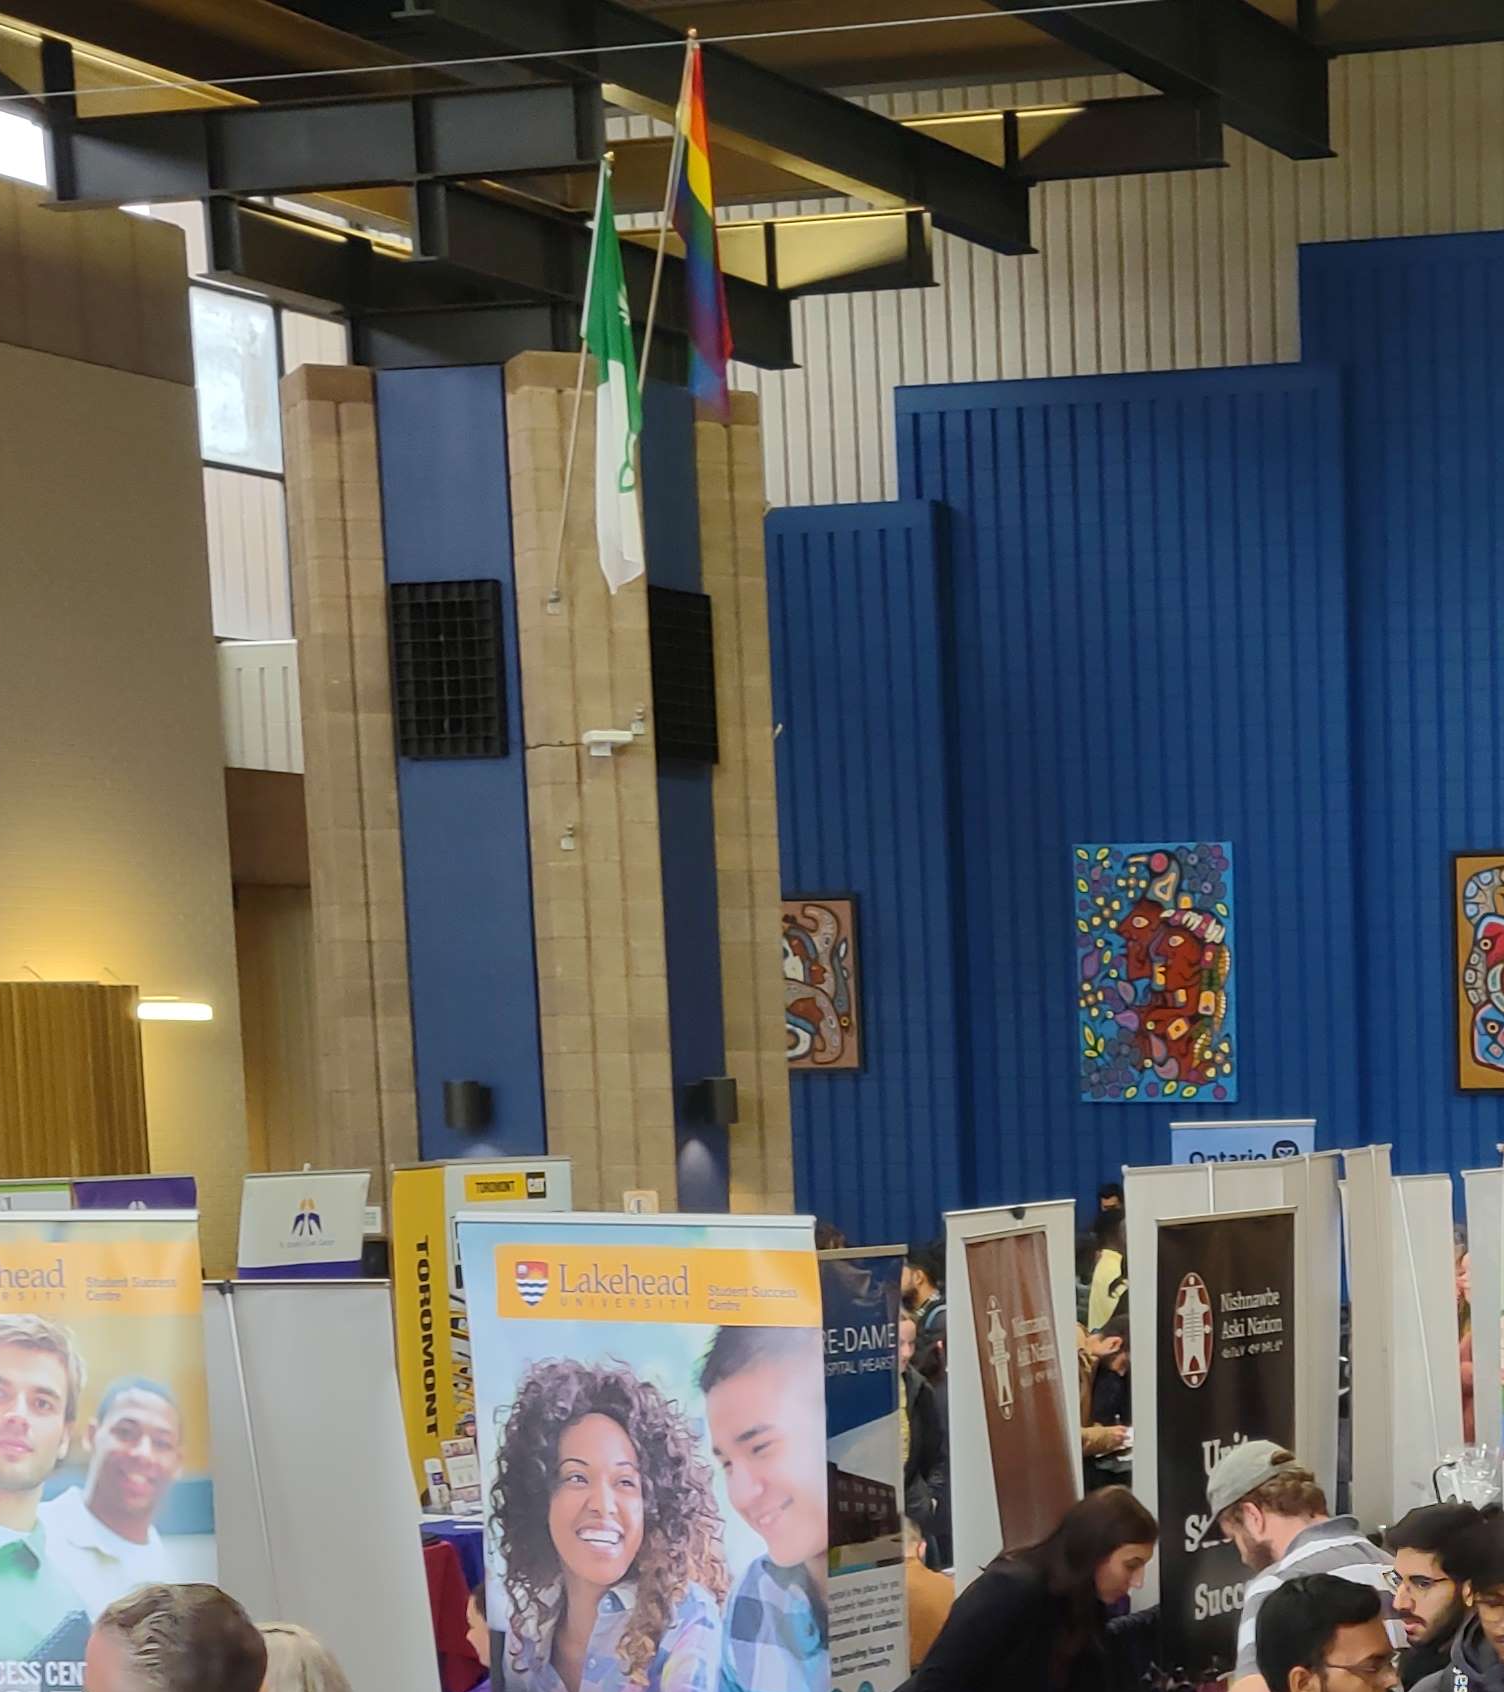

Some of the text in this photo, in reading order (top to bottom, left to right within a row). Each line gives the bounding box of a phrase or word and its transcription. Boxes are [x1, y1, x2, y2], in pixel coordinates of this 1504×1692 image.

[558, 1263, 689, 1296] Lakehead
[559, 1297, 690, 1309] UNIVERSITY
[1219, 1287, 1281, 1312] Nishnawbe
[414, 1235, 440, 1438] TOROMONT
[1221, 1314, 1284, 1340] Aski Nation
[1194, 1583, 1244, 1620] Succ
[43, 1661, 88, 1687] CENT
